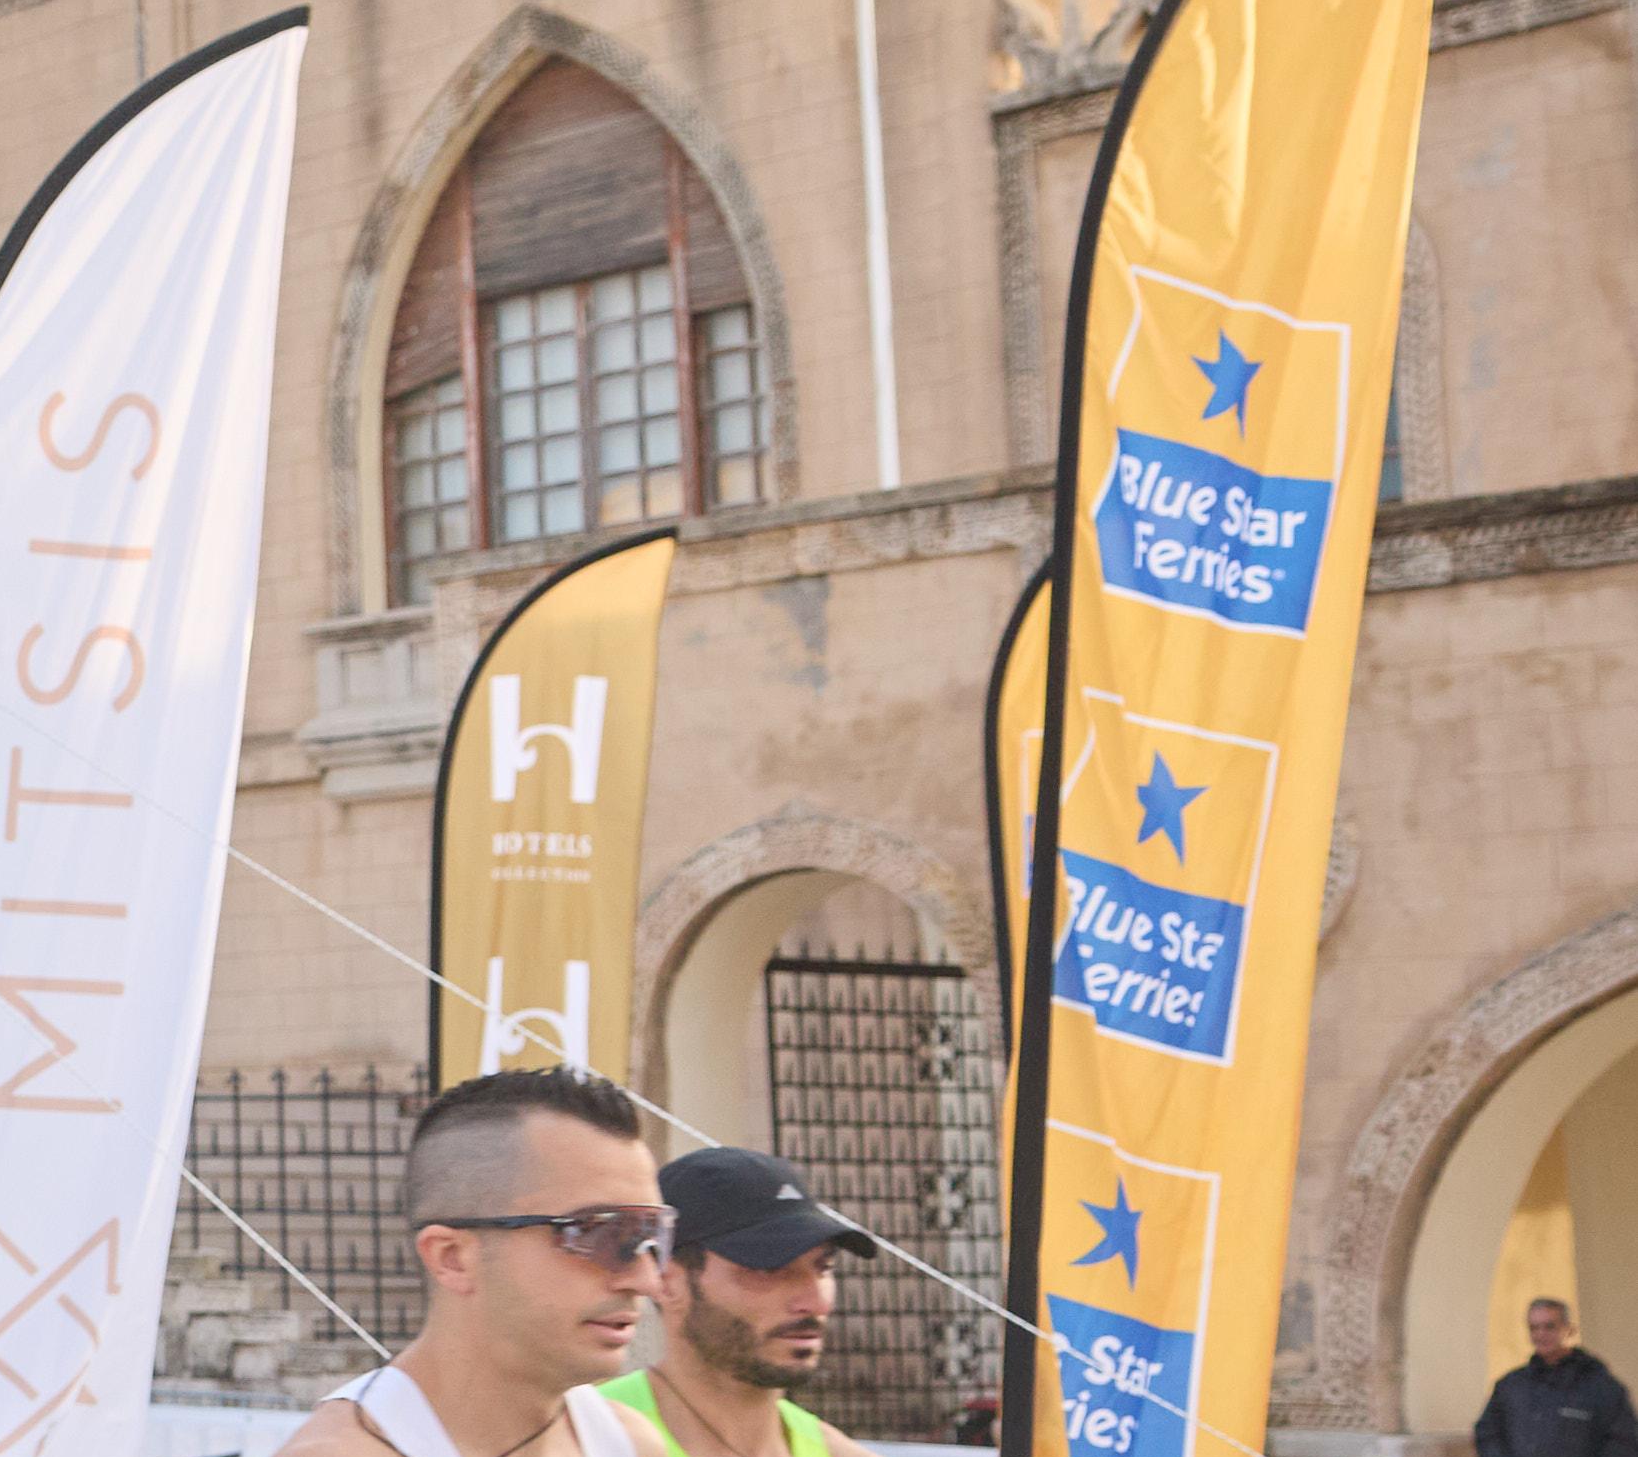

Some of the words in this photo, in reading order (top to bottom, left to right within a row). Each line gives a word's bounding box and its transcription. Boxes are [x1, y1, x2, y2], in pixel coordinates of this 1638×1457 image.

[1120, 453, 1216, 526] Blue
[1224, 486, 1307, 548] Star
[1134, 524, 1273, 604] Ferries
[1160, 911, 1225, 972] Sta
[1077, 943, 1204, 1027] errie
[1083, 1335, 1164, 1395] Star
